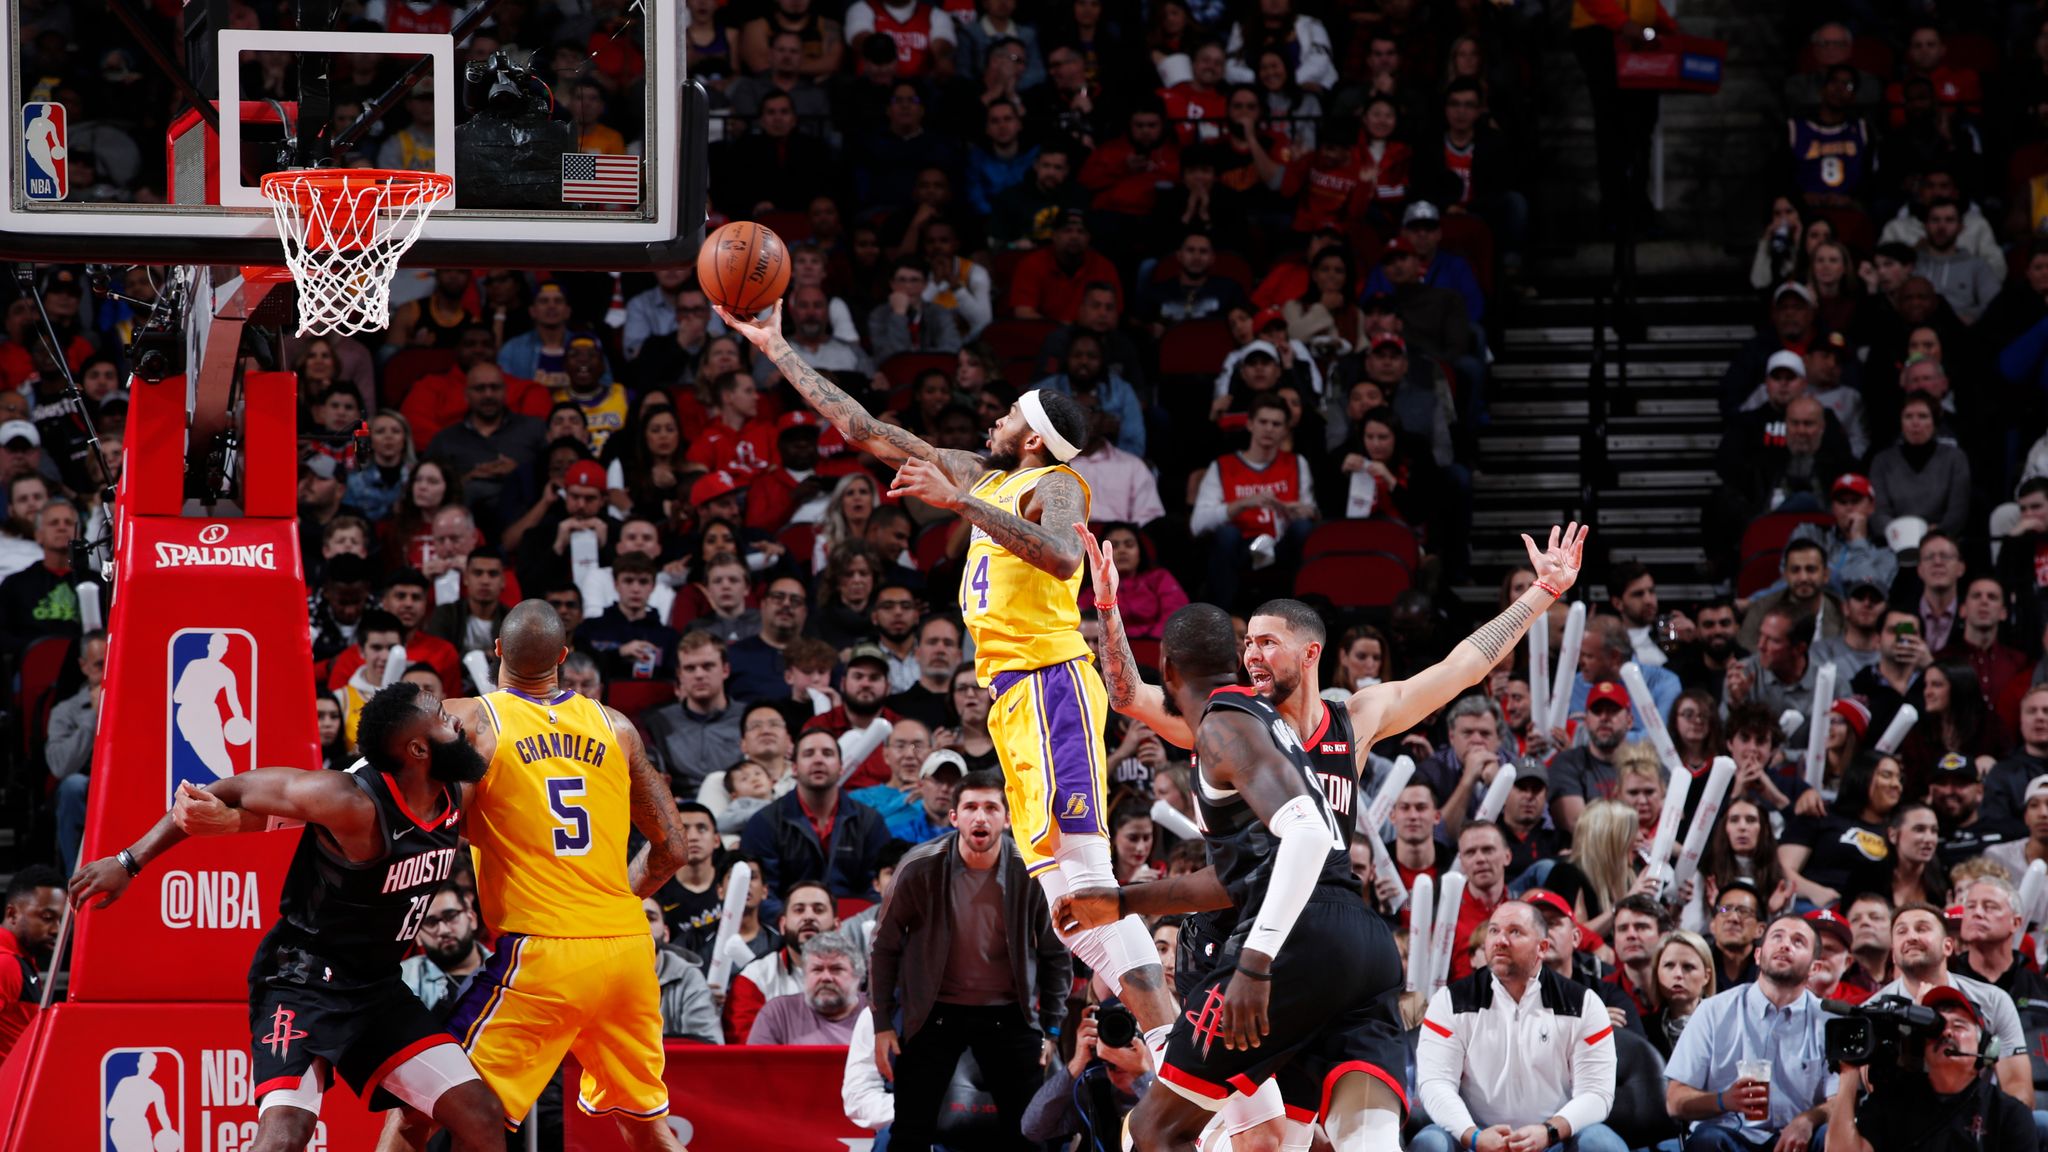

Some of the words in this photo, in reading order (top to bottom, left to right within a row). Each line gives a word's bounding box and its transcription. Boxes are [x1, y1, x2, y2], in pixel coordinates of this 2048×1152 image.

[30, 178, 52, 194] NBA
[1821, 157, 1844, 187] 8
[155, 541, 277, 570] SPALDING
[515, 733, 607, 768] CHANDLER
[545, 776, 593, 857] 5
[160, 869, 262, 930] @NBA
[396, 893, 431, 942] 13
